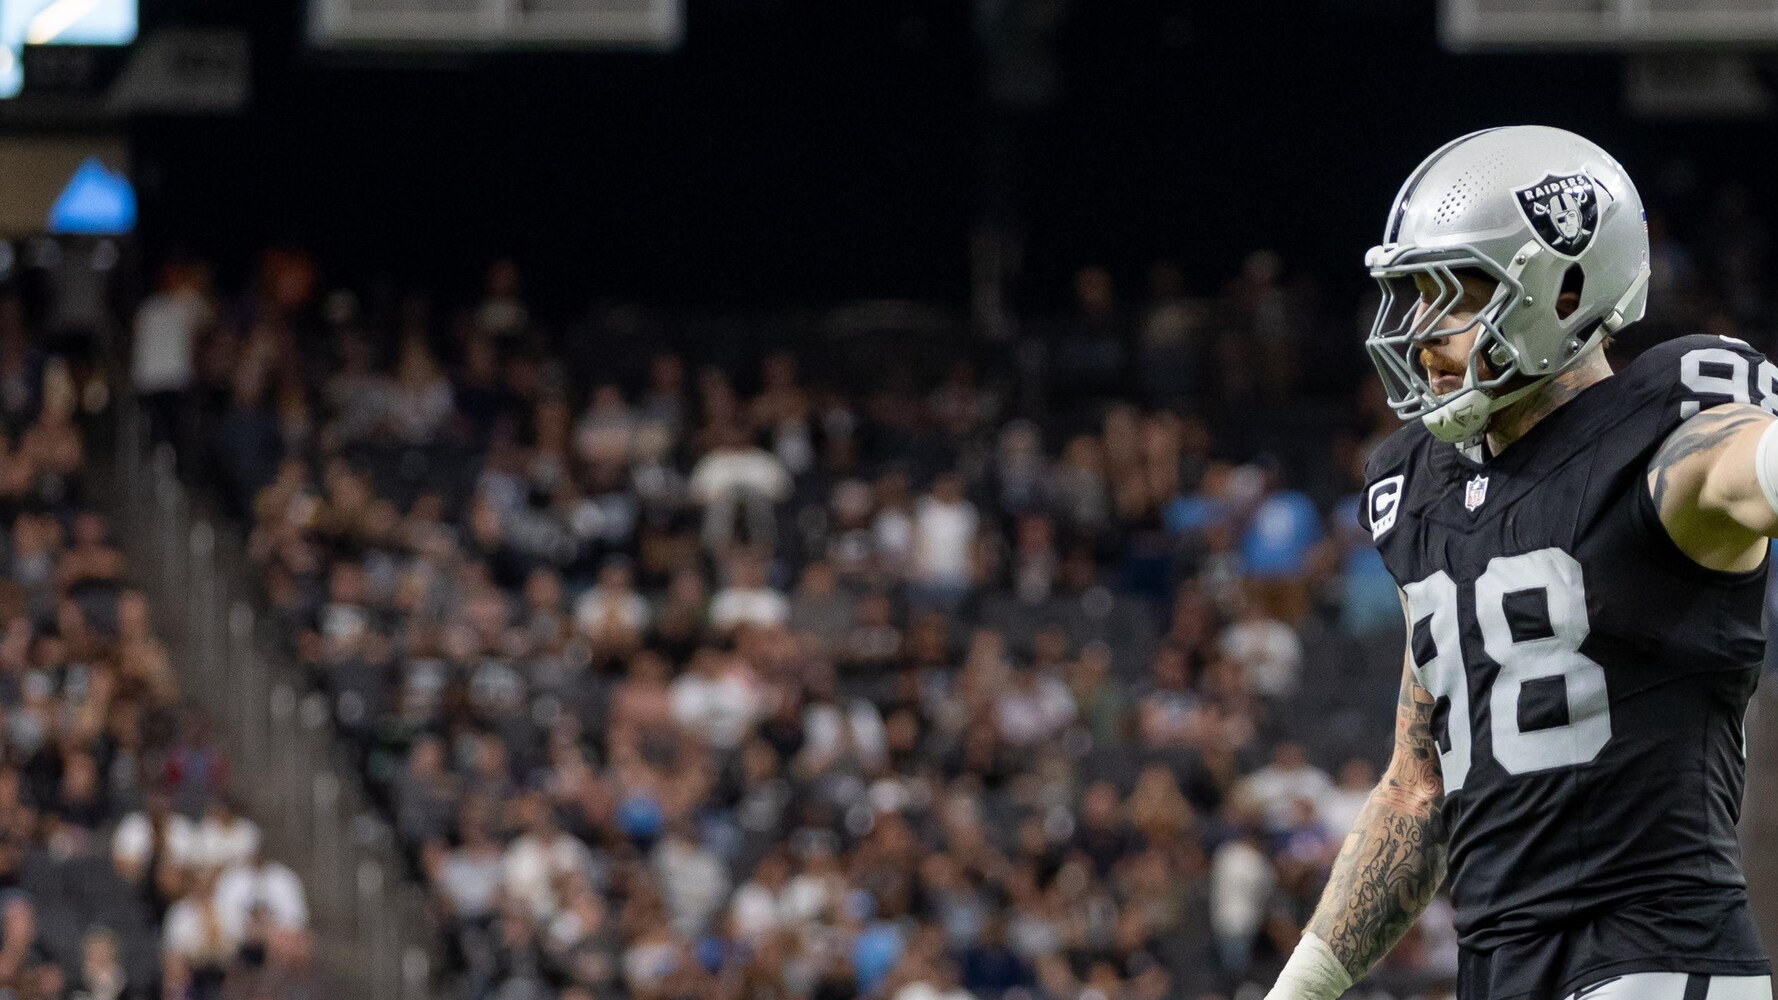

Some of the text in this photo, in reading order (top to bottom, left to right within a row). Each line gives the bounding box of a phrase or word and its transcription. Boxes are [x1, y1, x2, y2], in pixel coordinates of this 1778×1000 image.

[1524, 175, 1586, 201] RAIDERS
[1371, 482, 1398, 523] C
[1404, 547, 1613, 797] 98
